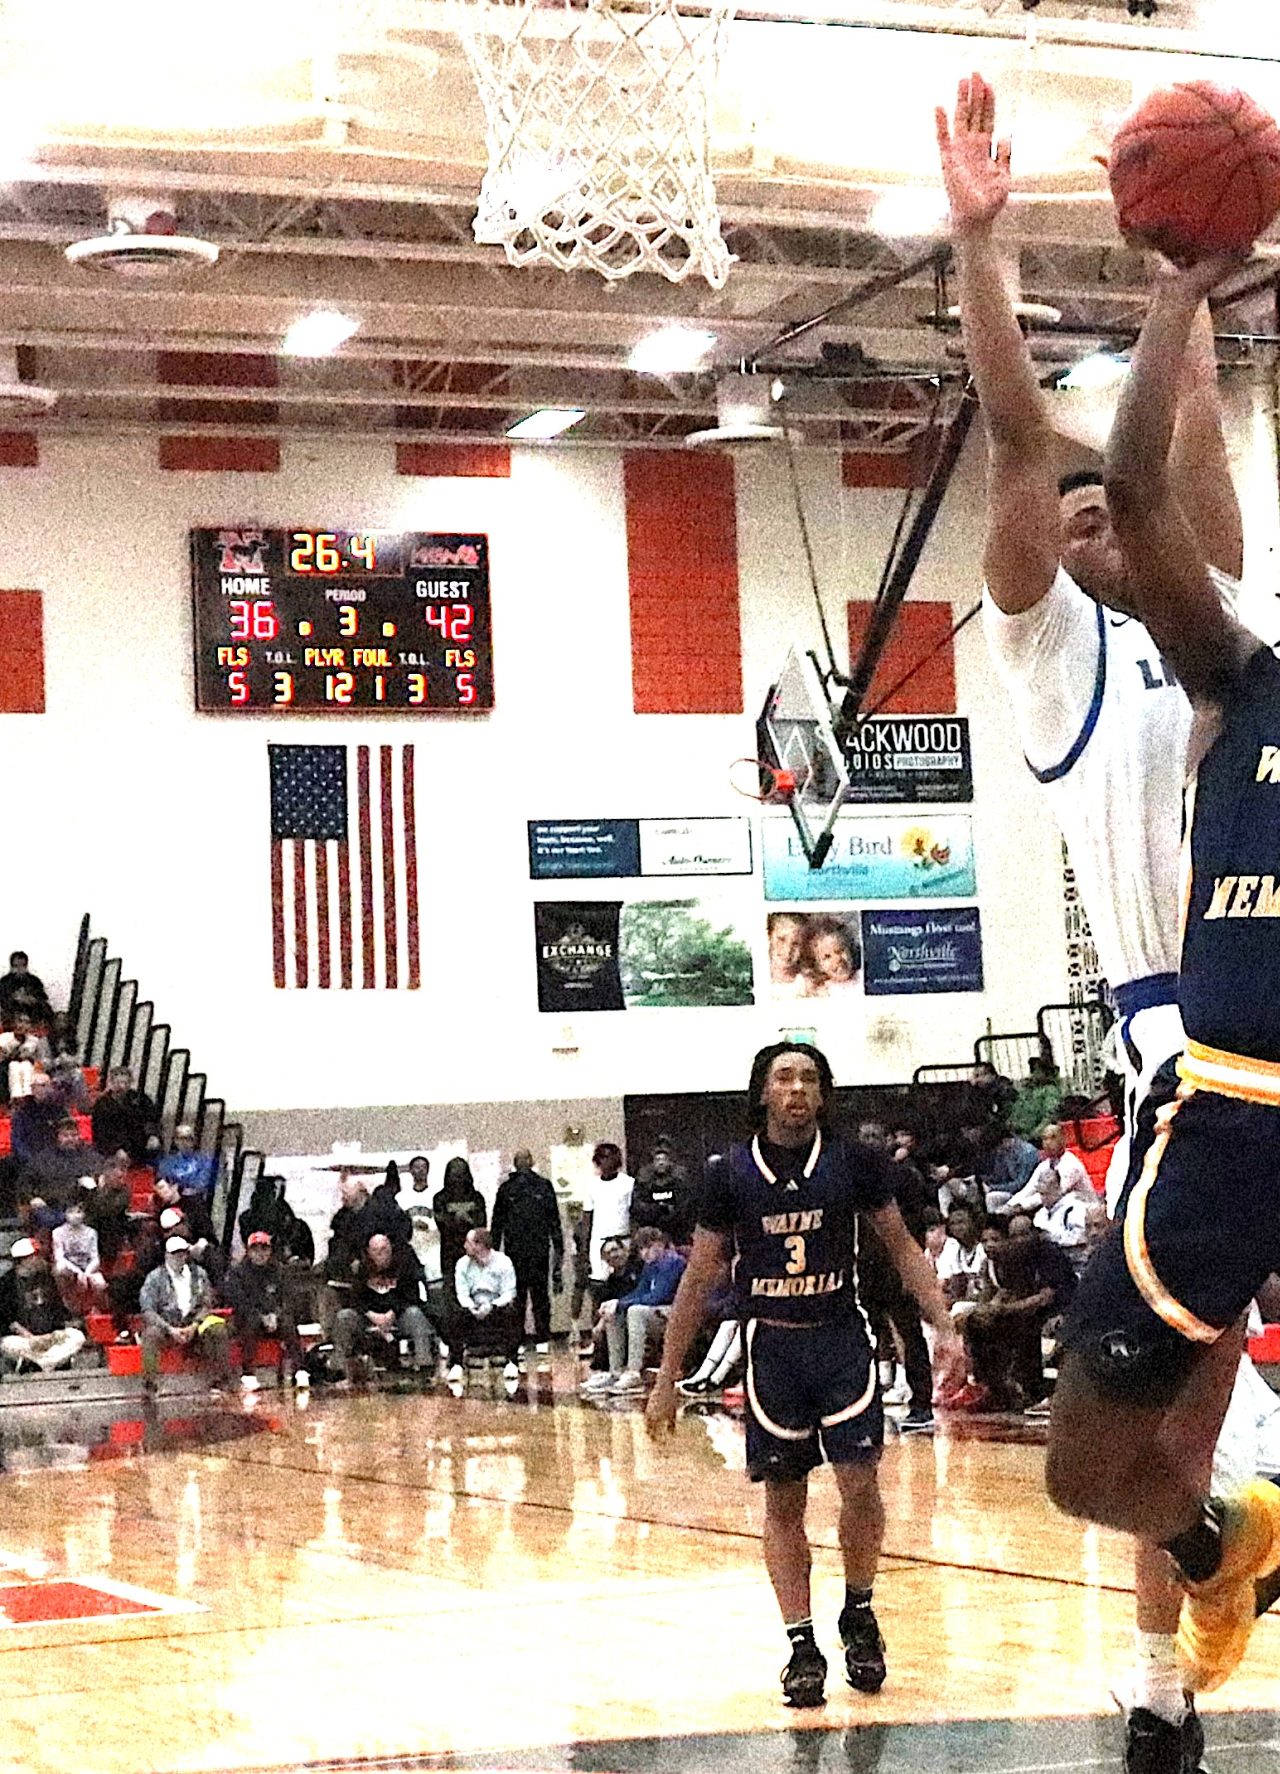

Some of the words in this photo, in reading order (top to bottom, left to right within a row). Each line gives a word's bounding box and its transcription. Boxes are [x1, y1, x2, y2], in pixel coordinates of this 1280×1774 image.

[291, 533, 377, 572] 26.4
[221, 577, 270, 596] HOME
[325, 589, 367, 601] PERIOD
[416, 580, 470, 599] GUEST
[229, 600, 278, 640] 36
[339, 605, 358, 636] 3
[426, 603, 475, 641] 42
[218, 647, 249, 666] FLS
[305, 647, 344, 667] PLYR
[353, 648, 392, 667] FOUL
[445, 649, 477, 668] FLS
[228, 671, 248, 703] 5
[275, 672, 295, 703] 3
[408, 673, 427, 703] 3
[457, 673, 477, 704] 5
[849, 835, 893, 856] Bird
[542, 944, 612, 959] EXCHANGE
[761, 1208, 824, 1235] WAYNE
[784, 1235, 806, 1275] 3
[751, 1269, 844, 1297] MEMORIAL
